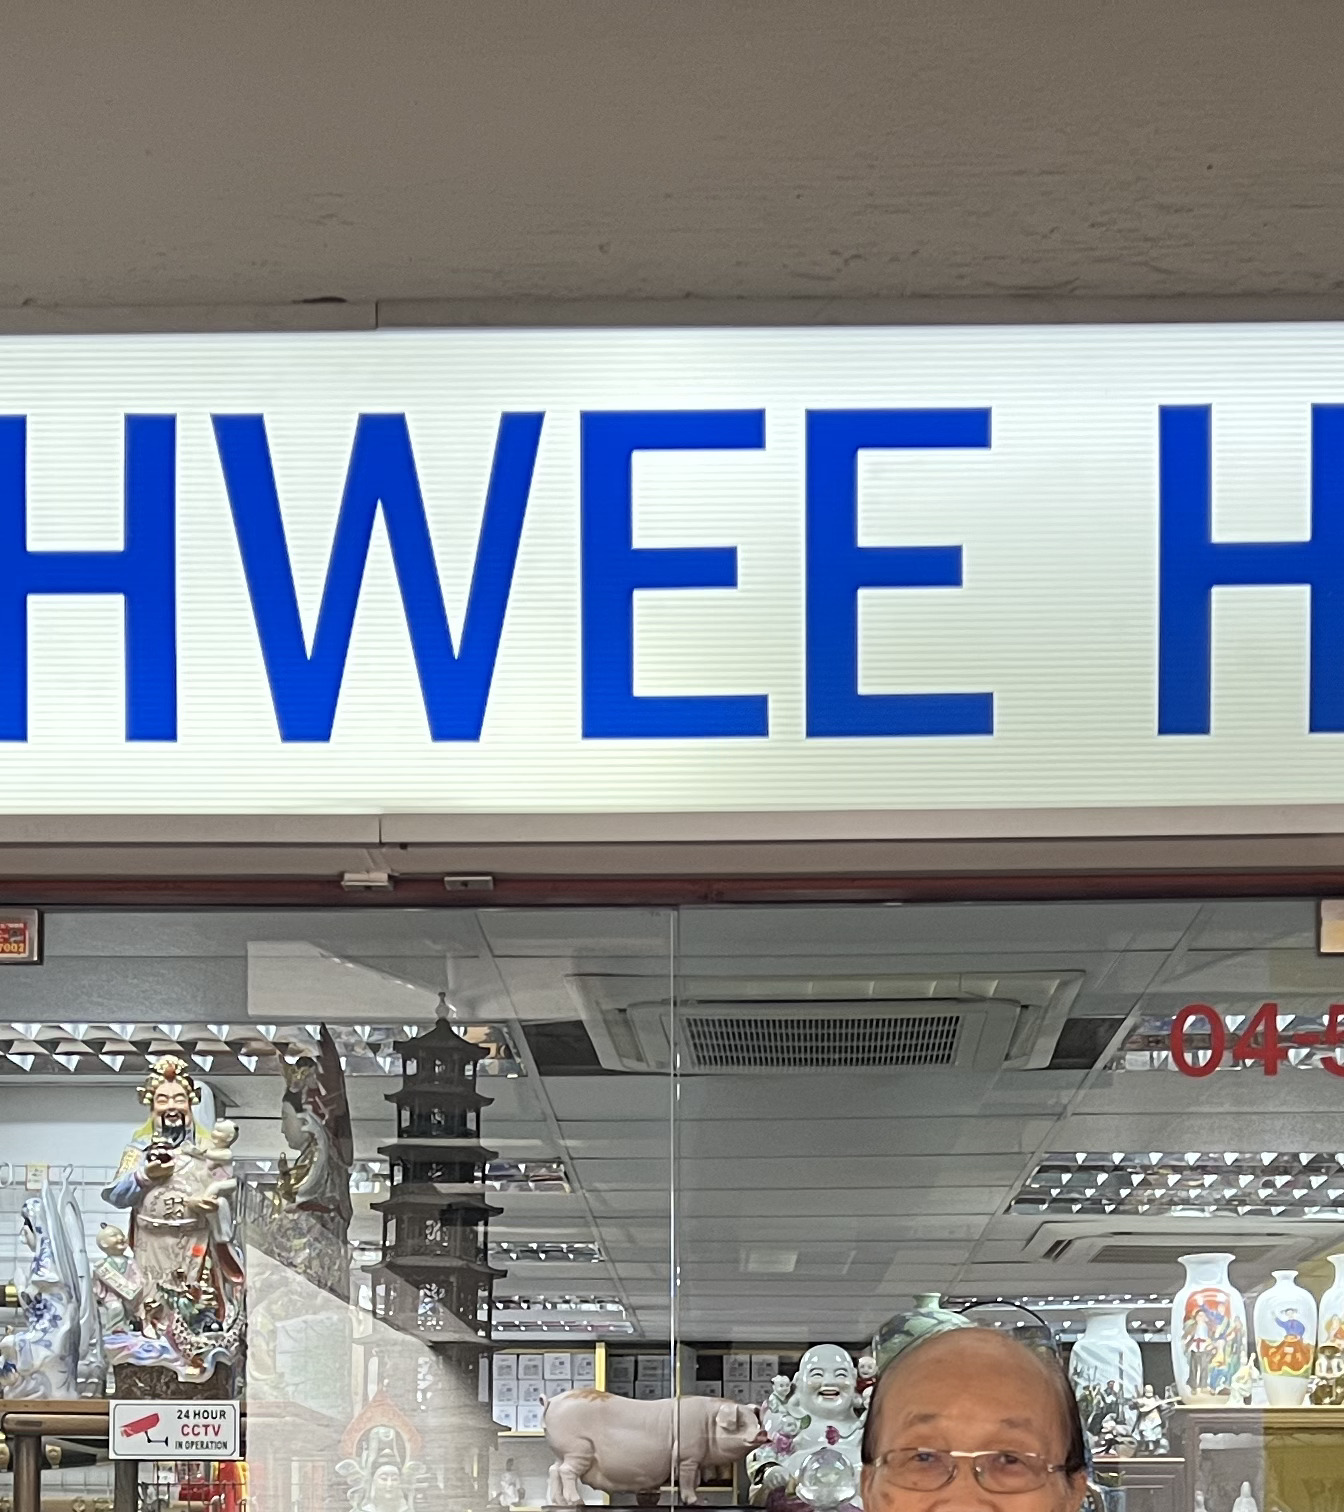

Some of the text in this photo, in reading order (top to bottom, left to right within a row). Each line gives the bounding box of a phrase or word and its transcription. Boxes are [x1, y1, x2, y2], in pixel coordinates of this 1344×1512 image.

[177, 1409, 226, 1420] 24 HOUR
[181, 1423, 221, 1437] CCTV
[175, 1440, 228, 1450] IN OPERATION
